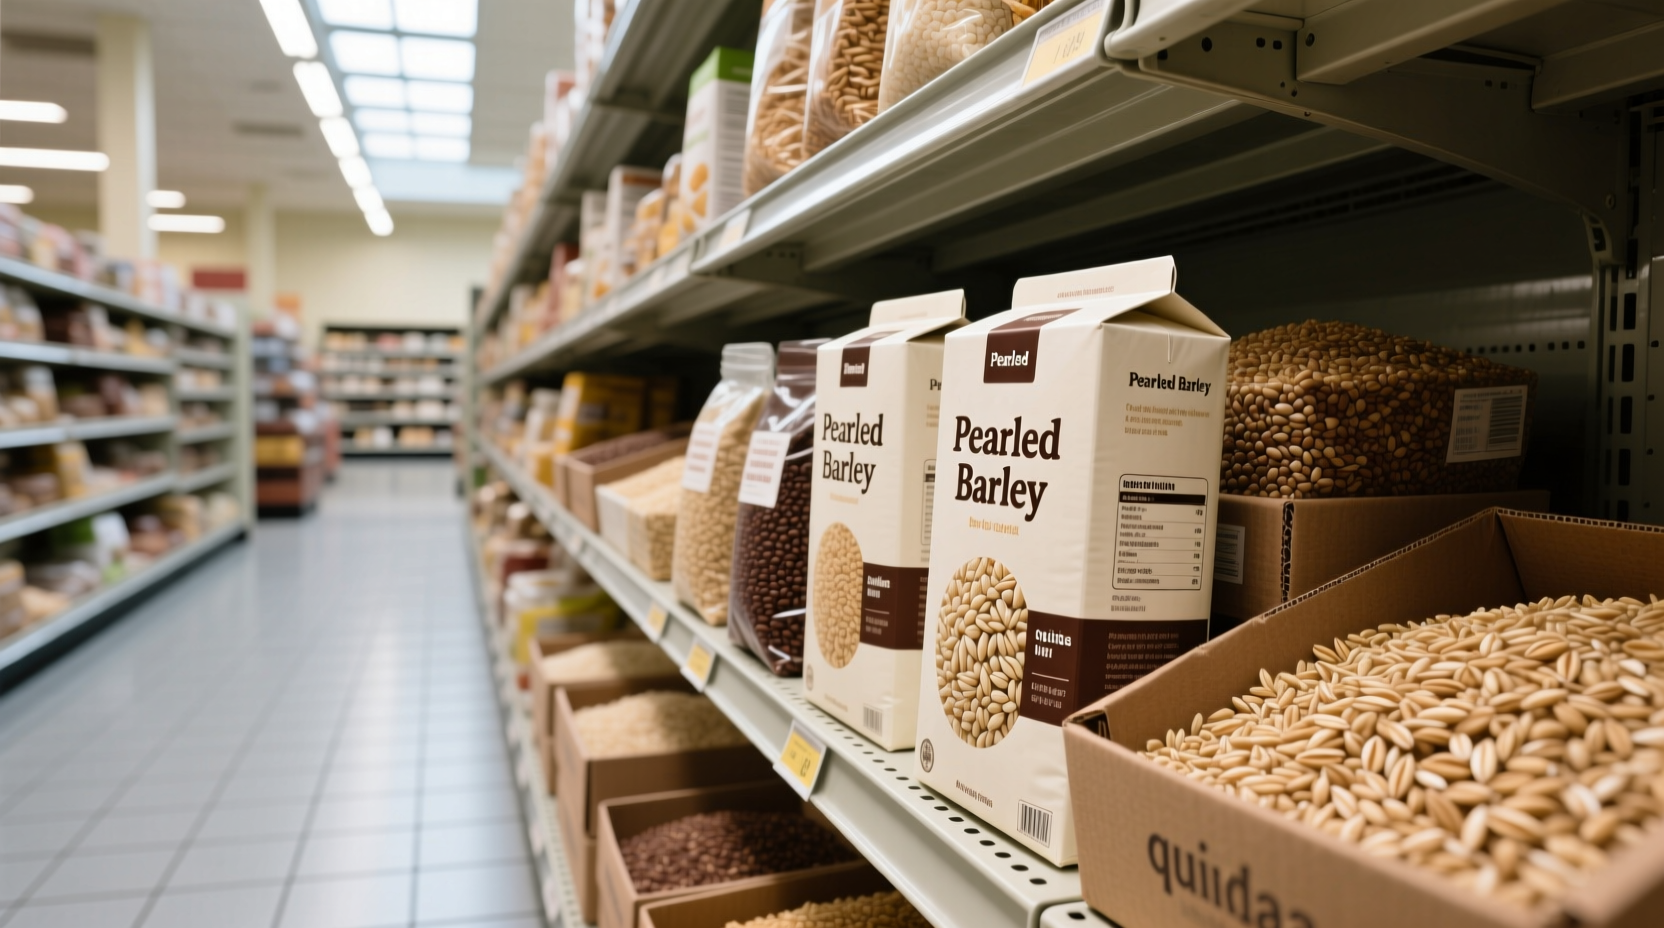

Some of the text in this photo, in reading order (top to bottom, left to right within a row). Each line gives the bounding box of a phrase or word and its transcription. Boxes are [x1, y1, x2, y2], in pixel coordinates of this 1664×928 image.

[1128, 371, 1176, 391] Pearled
[822, 412, 884, 447] Pearled
[952, 415, 1062, 460] Pearled
[822, 450, 877, 494] Barley
[954, 462, 1049, 522] Barley
